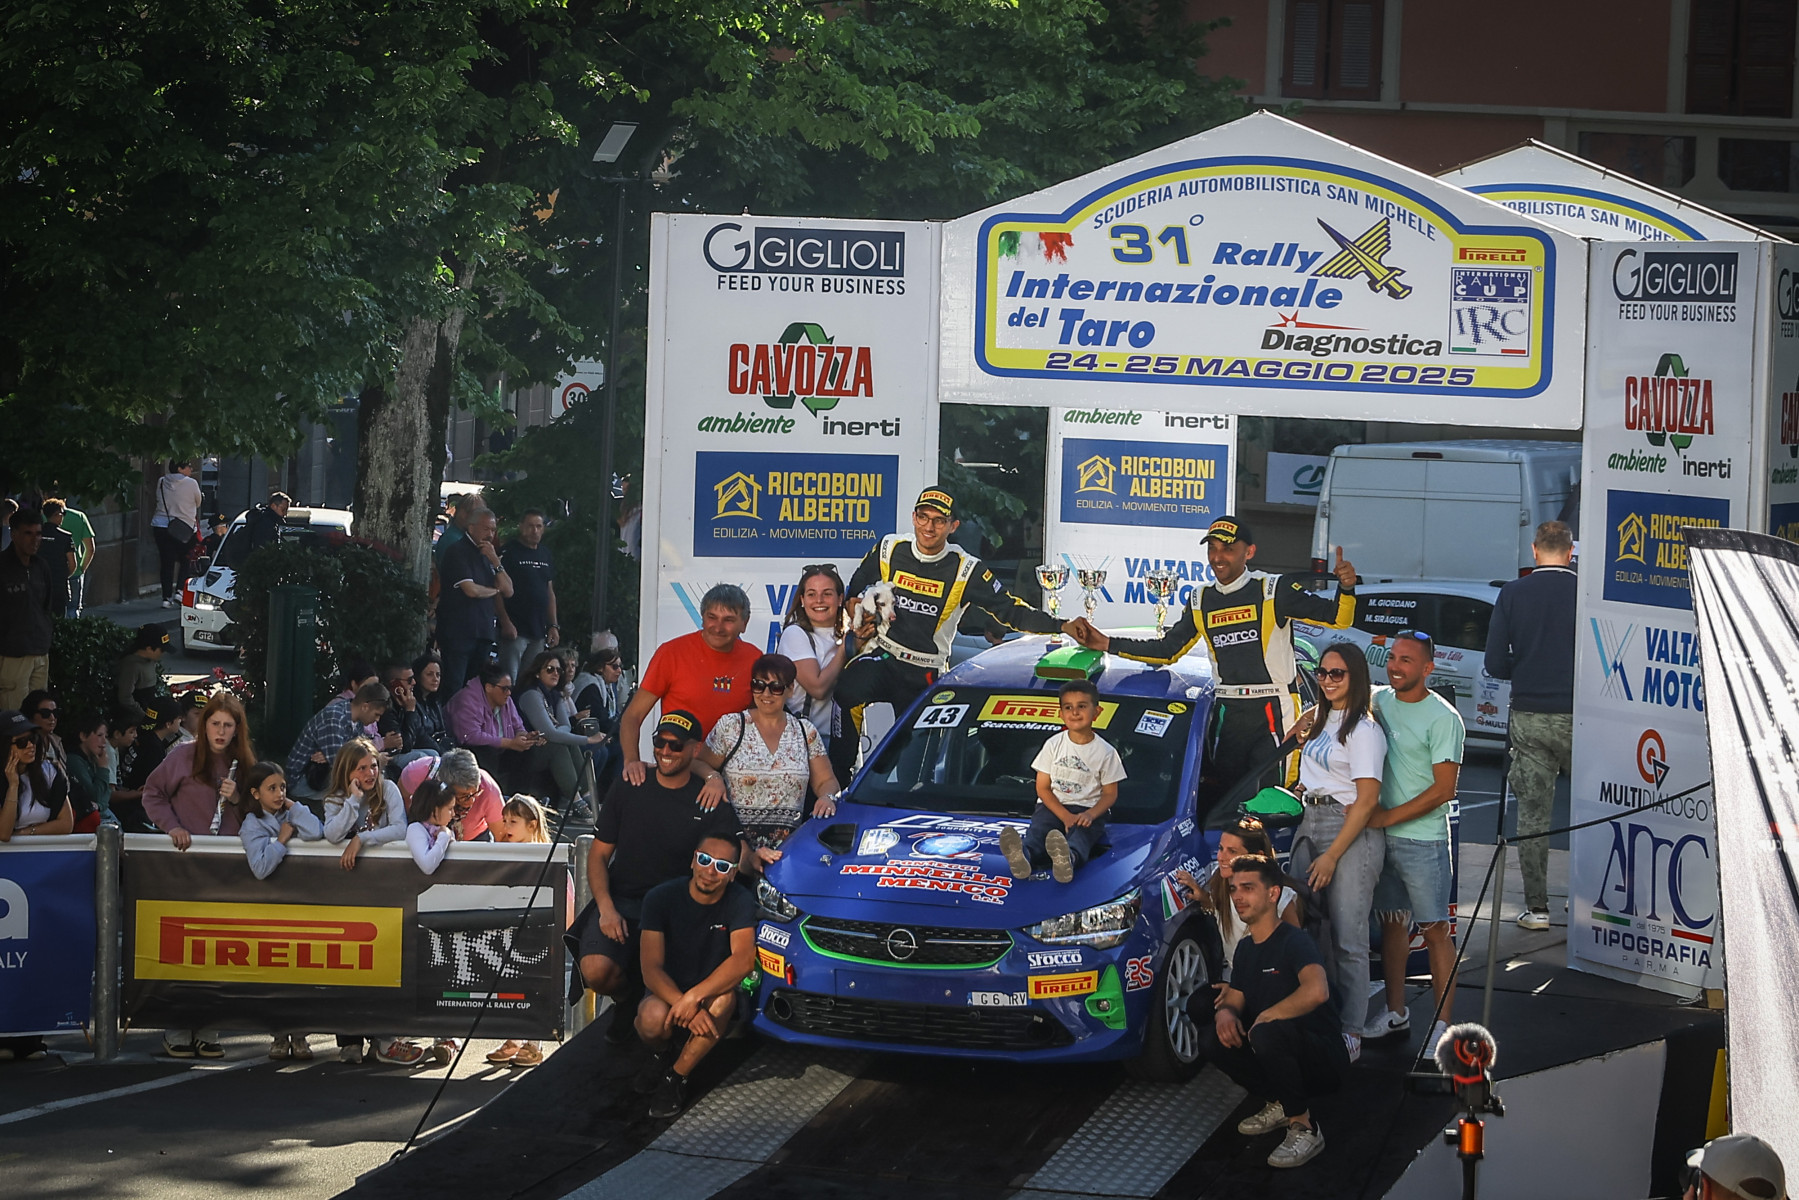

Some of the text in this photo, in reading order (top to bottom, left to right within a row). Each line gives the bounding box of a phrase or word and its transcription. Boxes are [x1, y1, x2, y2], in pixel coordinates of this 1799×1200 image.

[1093, 176, 1436, 242] SCUDERIA AUTOMOBILISTICA SAN MICHELE
[1502, 202, 1586, 219] OBILISTICA
[1590, 208, 1619, 228] SAN
[758, 237, 901, 271] GIGLIOLI
[1212, 242, 1324, 273] Rally
[1458, 247, 1527, 262] PIRELLI
[717, 275, 906, 295] FEED YOUR BUSINESS
[1005, 270, 1343, 310] Internazionale
[1455, 275, 1527, 287] RALLY
[1455, 284, 1527, 297] CUP
[1645, 263, 1735, 297] GIGLIOLI
[1453, 304, 1528, 346] IRC
[1619, 303, 1737, 323] FEED YOUR BUSINESS
[1007, 307, 1155, 348] del Taro
[1261, 328, 1442, 357] Diagnostica
[728, 343, 874, 398] CAVOZZA
[1185, 357, 1354, 381] MAGGIO
[1360, 365, 1476, 386] 2025
[1625, 376, 1714, 435] CAVOZZA
[697, 411, 901, 437] ambiente inerti
[1063, 408, 1230, 430] ambiente inerti
[1120, 455, 1216, 480] RICCOBONI
[1607, 449, 1731, 479] ambiente inerti
[767, 471, 883, 498] RICCOBONI
[1129, 477, 1205, 500] ALBERTO
[778, 498, 870, 523] ALBERTO
[1076, 499, 1113, 510] EDILIZIA
[1122, 501, 1178, 513] MOVIMENTO
[1180, 503, 1211, 515] TERRA
[713, 527, 759, 539] EDILIZIA
[769, 528, 838, 540] MOVIMENTO
[841, 528, 877, 541] TERRA
[1656, 542, 1689, 570] ALBE
[898, 574, 939, 595] PIRELLI
[1615, 570, 1643, 584] EDILIZIA
[1212, 607, 1252, 625] PIRELLI
[1378, 599, 1417, 609] GIORDANO
[1374, 615, 1409, 625] SIRAGUSA
[1213, 629, 1258, 647] sparco
[1645, 626, 1699, 668] VALTA
[1641, 666, 1704, 712] MOTO
[922, 707, 961, 725] 43
[980, 720, 1063, 732] ScaccoMatto
[1600, 780, 1709, 822] MULTIDIALOGO
[840, 864, 1013, 887] MINNELLA
[887, 859, 981, 872] PONTEGGI
[877, 877, 1008, 898] MENICO
[159, 915, 379, 971] PIRELLI
[1591, 925, 1713, 970] TIPOGRAFIA
[1622, 954, 1680, 976] PARMA
[1034, 976, 1093, 995] PIRELLI
[516, 1002, 531, 1010] CUP
